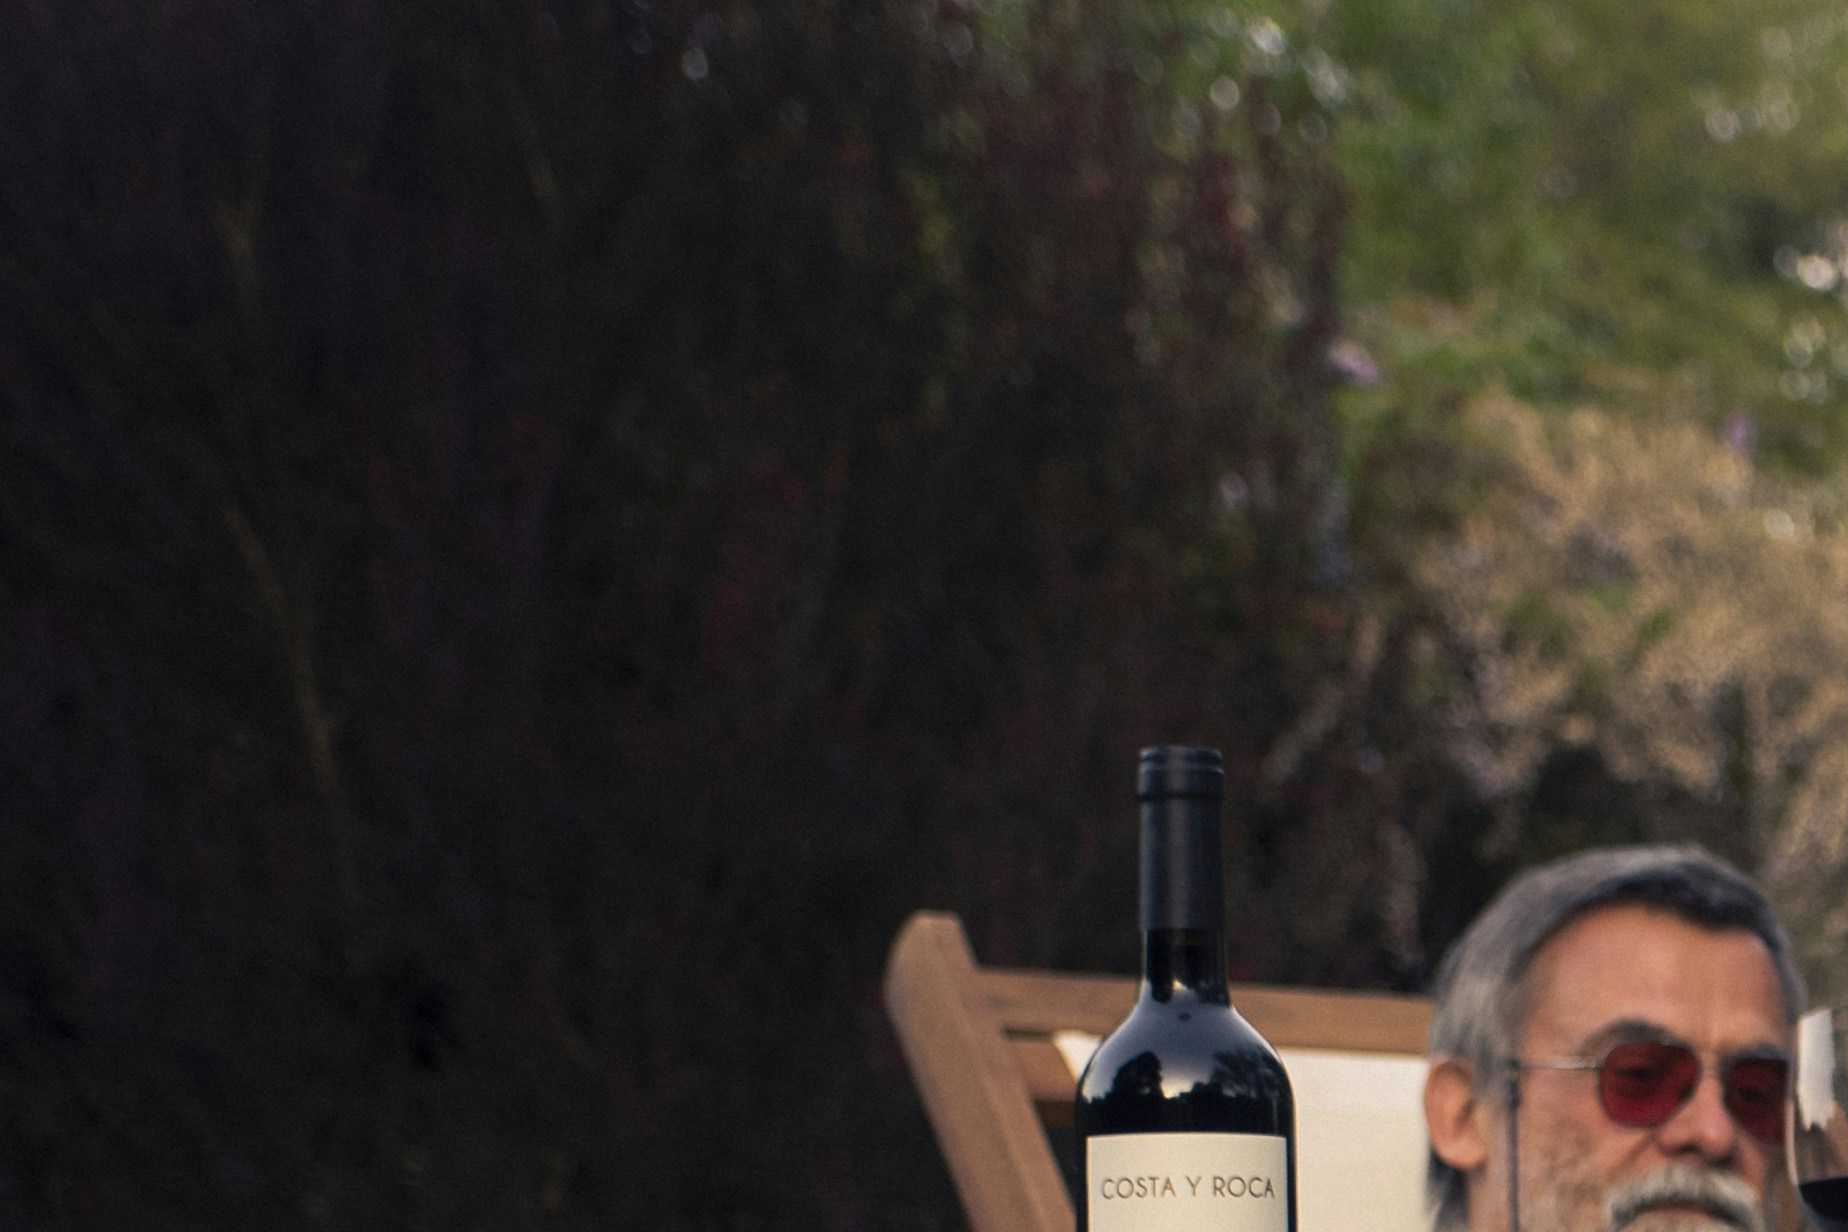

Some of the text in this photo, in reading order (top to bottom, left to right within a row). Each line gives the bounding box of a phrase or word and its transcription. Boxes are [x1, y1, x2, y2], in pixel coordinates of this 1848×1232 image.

[1102, 1176, 1275, 1200] COSTA Y ROCA
